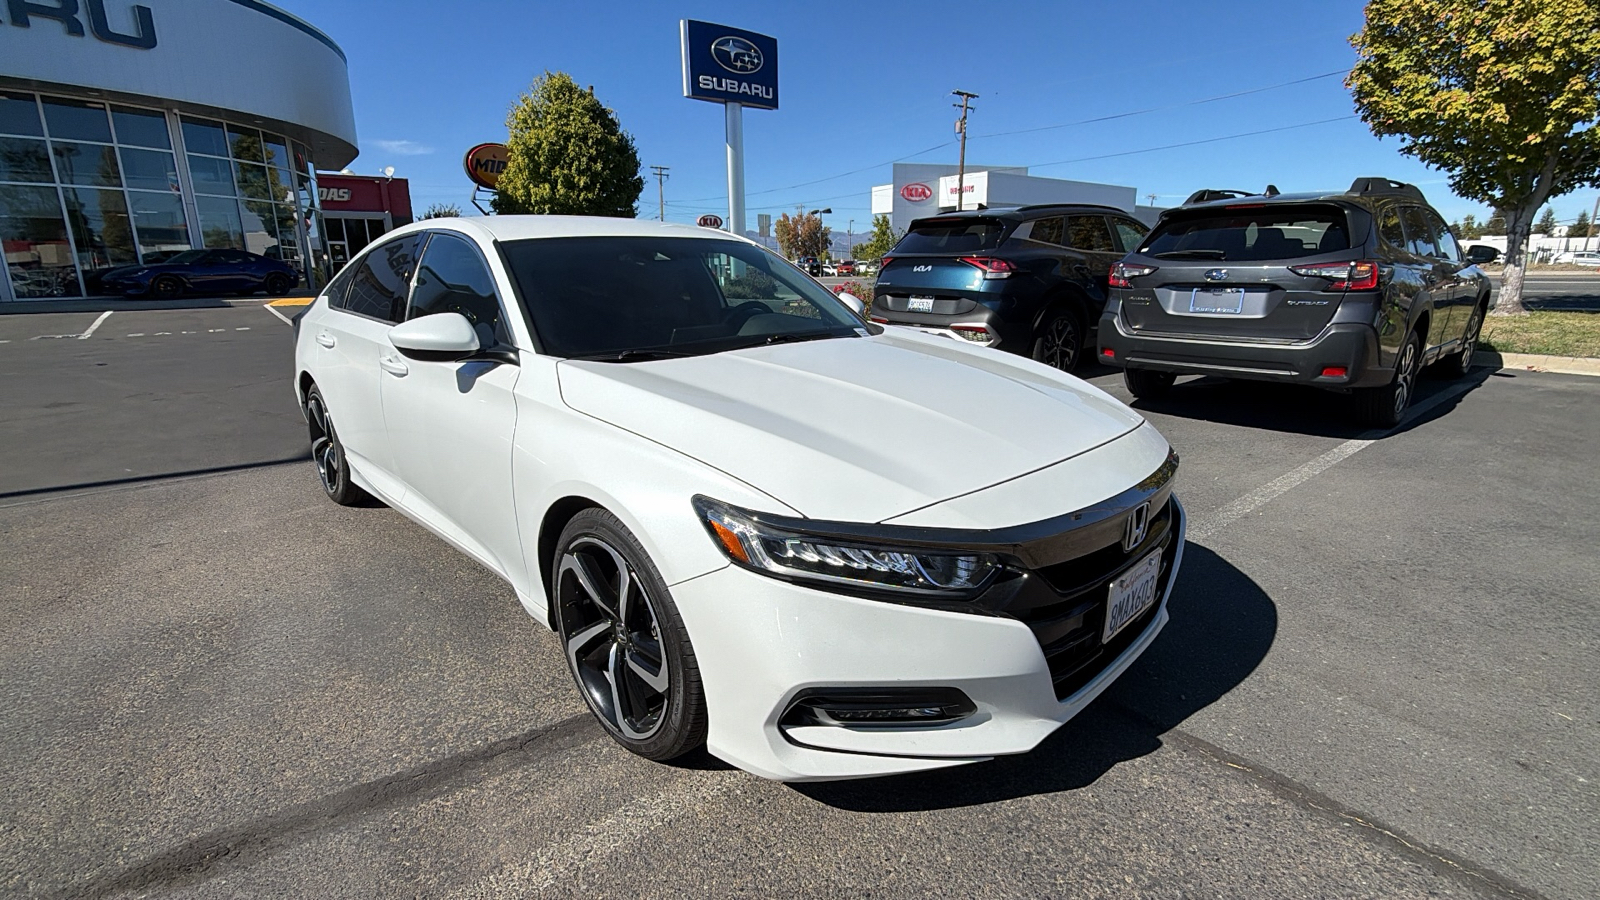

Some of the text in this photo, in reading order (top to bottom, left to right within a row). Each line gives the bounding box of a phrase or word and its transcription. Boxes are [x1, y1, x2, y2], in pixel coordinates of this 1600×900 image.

[0, 0, 157, 50] RU
[699, 75, 773, 99] SUBARU
[475, 154, 507, 173] MID
[318, 187, 350, 201] DAS
[1109, 575, 1155, 634] 8MAX603
